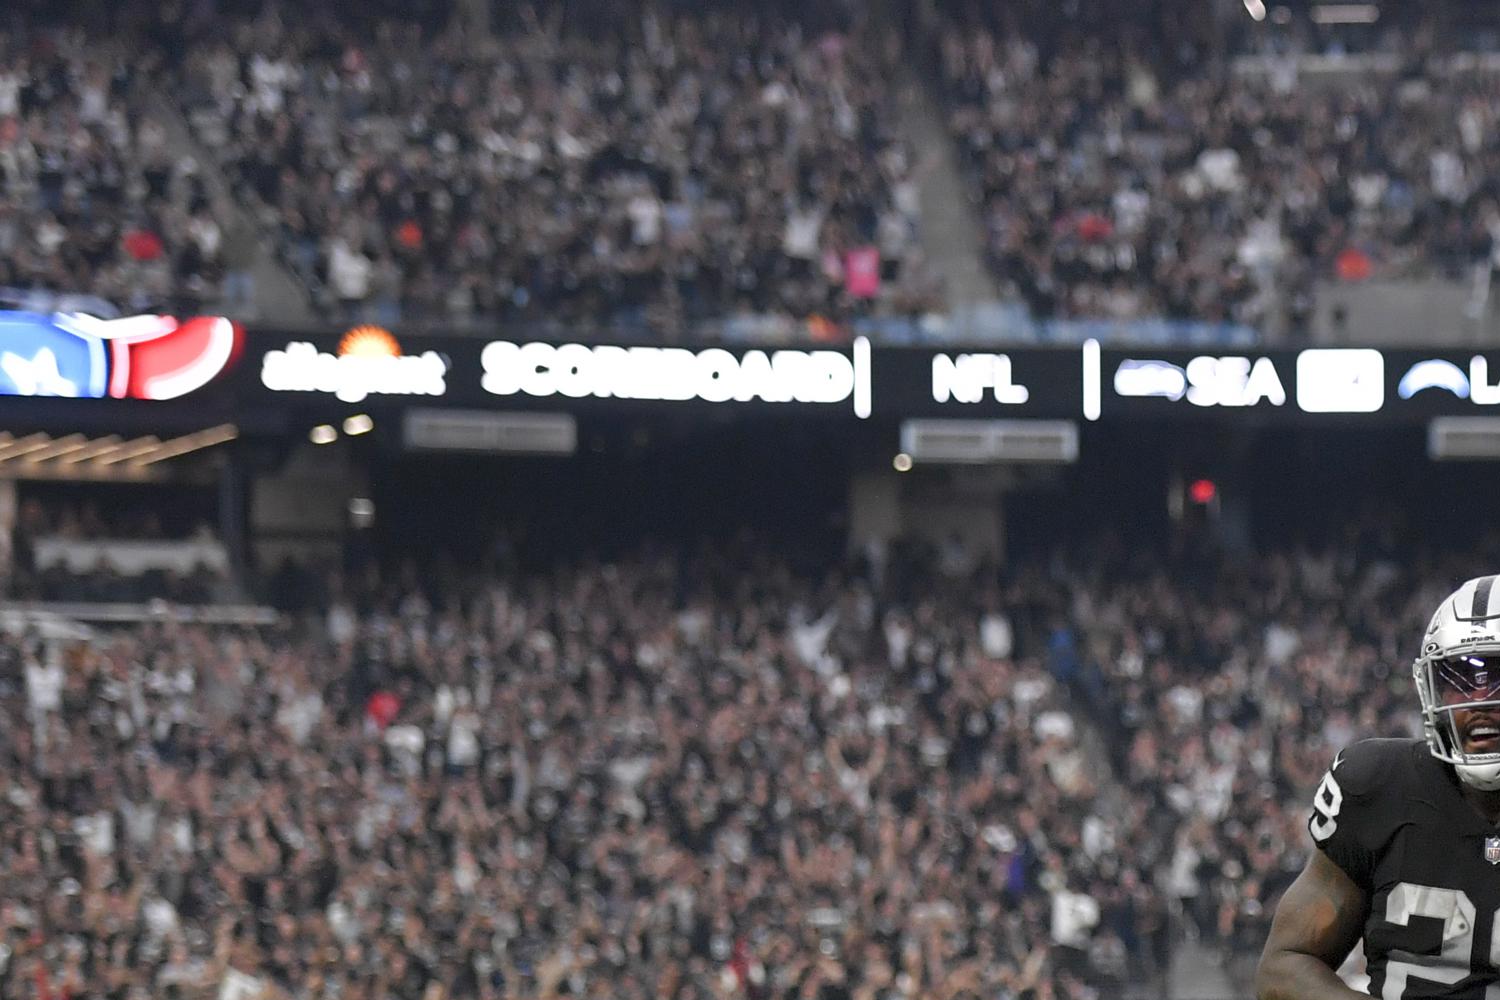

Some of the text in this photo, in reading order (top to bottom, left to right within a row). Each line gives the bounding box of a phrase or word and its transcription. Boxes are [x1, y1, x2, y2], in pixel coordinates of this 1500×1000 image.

[481, 341, 853, 402] SCOREBOARD
[933, 354, 1028, 403] NFL
[1186, 356, 1285, 406] SEA
